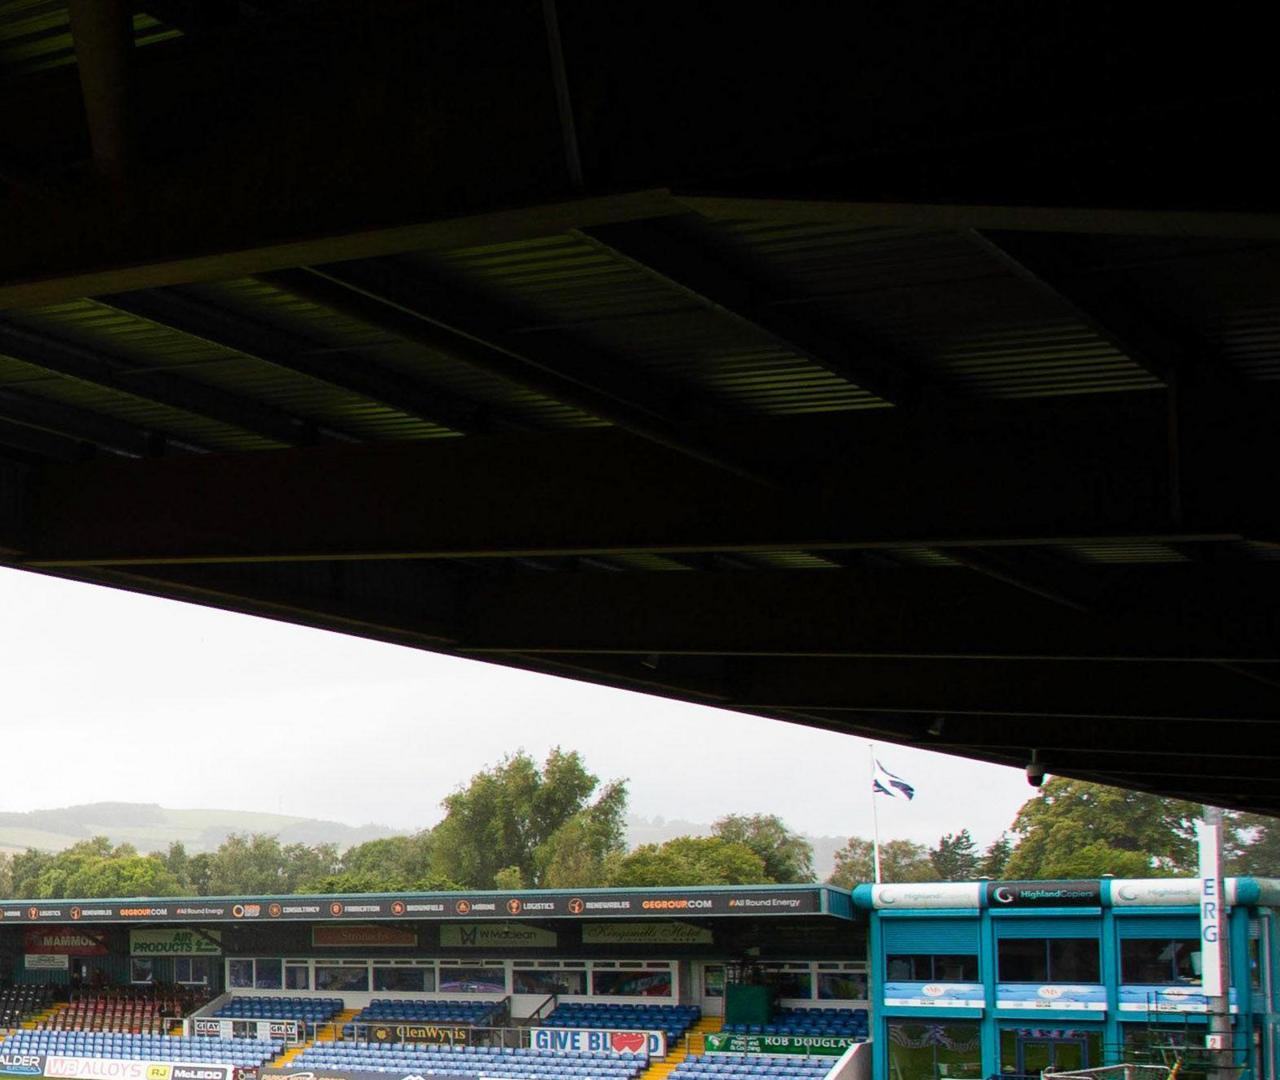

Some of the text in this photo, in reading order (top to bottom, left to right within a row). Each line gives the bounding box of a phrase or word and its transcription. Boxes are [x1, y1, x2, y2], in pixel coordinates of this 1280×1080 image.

[772, 898, 801, 907] Energy
[1203, 878, 1218, 943] ERG
[173, 932, 192, 942] AIR
[133, 942, 192, 953] PRODUCTS
[396, 1025, 466, 1041] GlenWyvis
[535, 1030, 659, 1053] GIVE BLD
[765, 1036, 789, 1046] ROB
[794, 1038, 853, 1049] DOUGLAS
[80, 1060, 139, 1077] ALLOYS
[151, 1068, 222, 1080] RJ McLEOD
